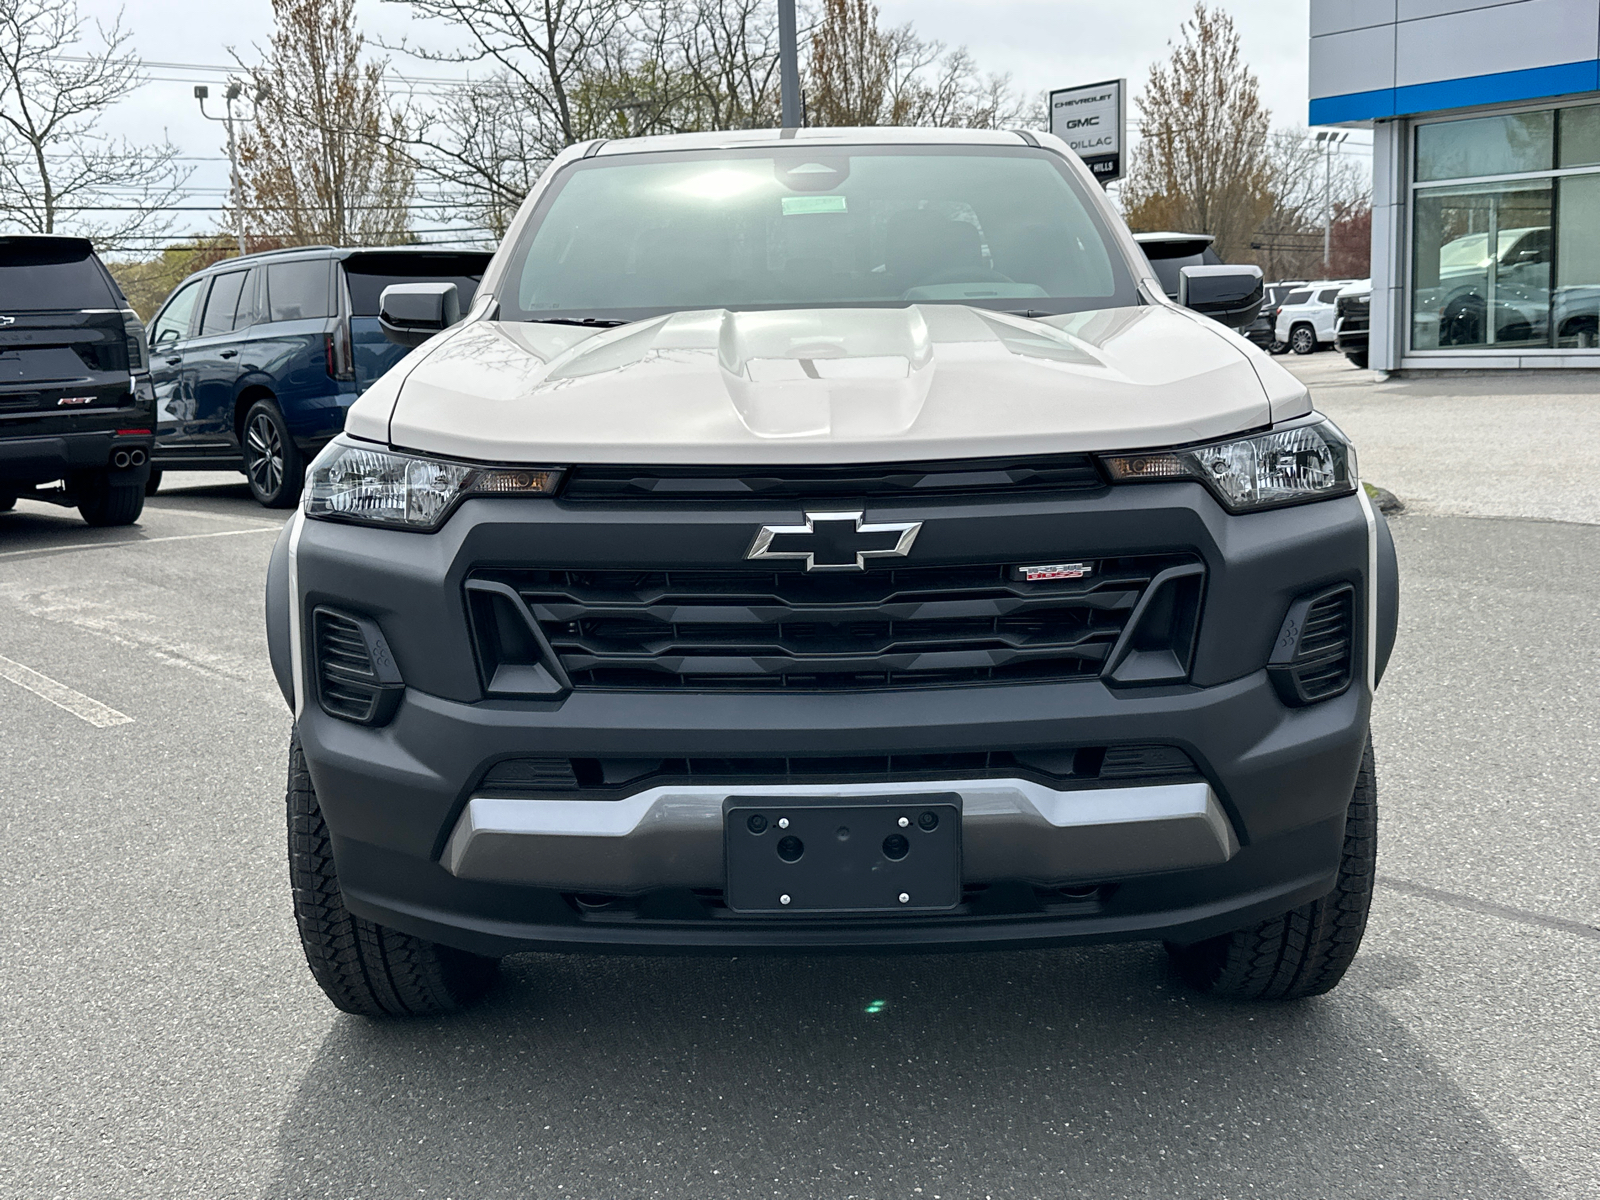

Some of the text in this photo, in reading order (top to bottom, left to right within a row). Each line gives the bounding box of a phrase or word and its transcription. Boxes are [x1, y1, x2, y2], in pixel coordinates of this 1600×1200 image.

[1054, 93, 1113, 109] CHEVROLET
[1066, 115, 1100, 130] GMC
[1067, 136, 1113, 150] DILLAC
[1093, 161, 1114, 173] HILLS
